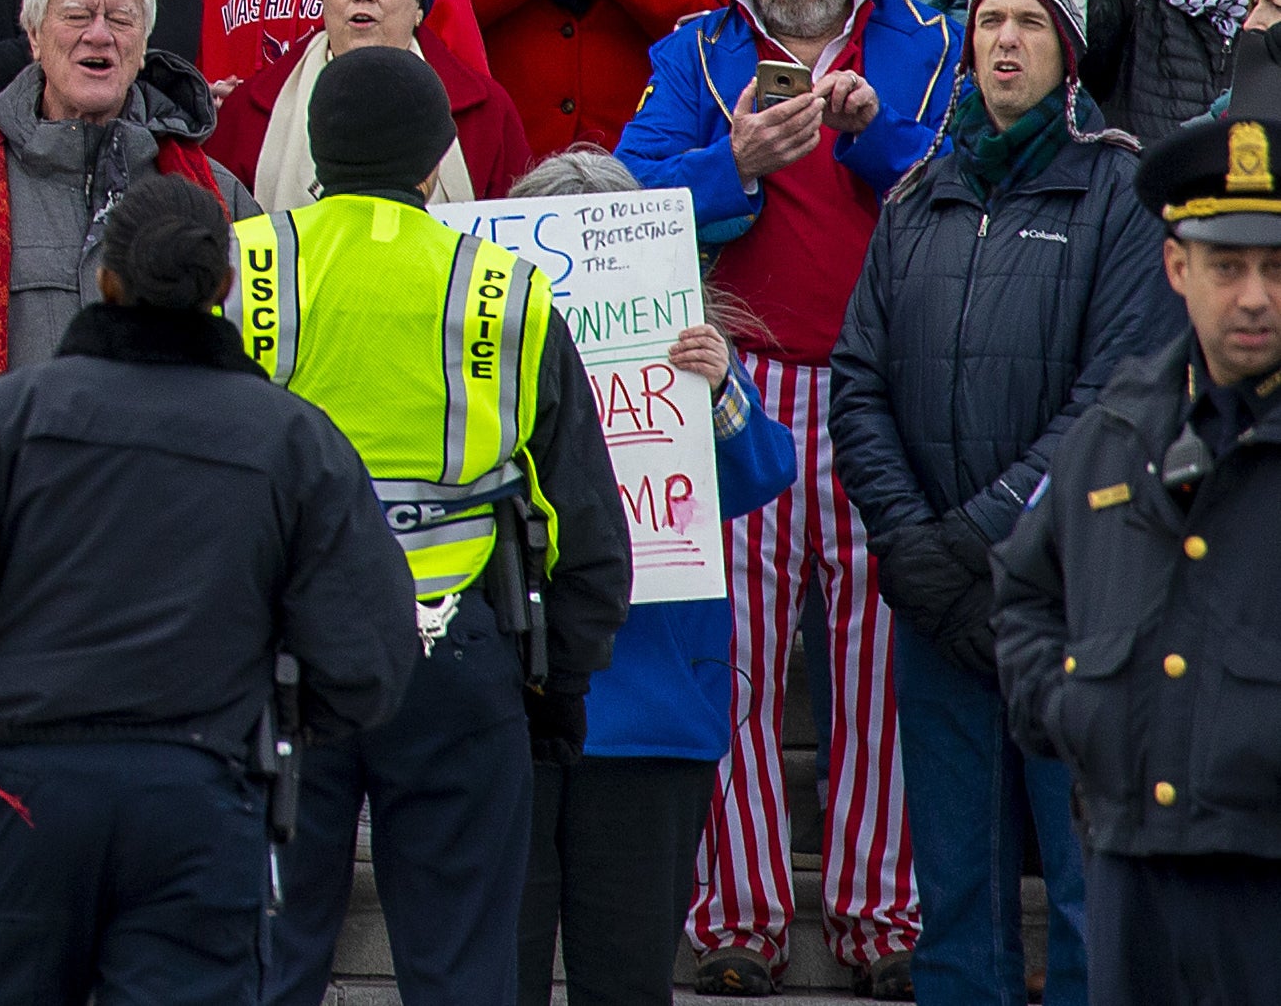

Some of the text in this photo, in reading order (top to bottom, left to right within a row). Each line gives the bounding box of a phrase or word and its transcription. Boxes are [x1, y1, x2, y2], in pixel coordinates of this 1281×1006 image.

[581, 220, 685, 252] PROTECTING
[610, 199, 685, 219] POLICIES
[248, 248, 276, 361] USCP
[470, 269, 506, 380] POLICE
